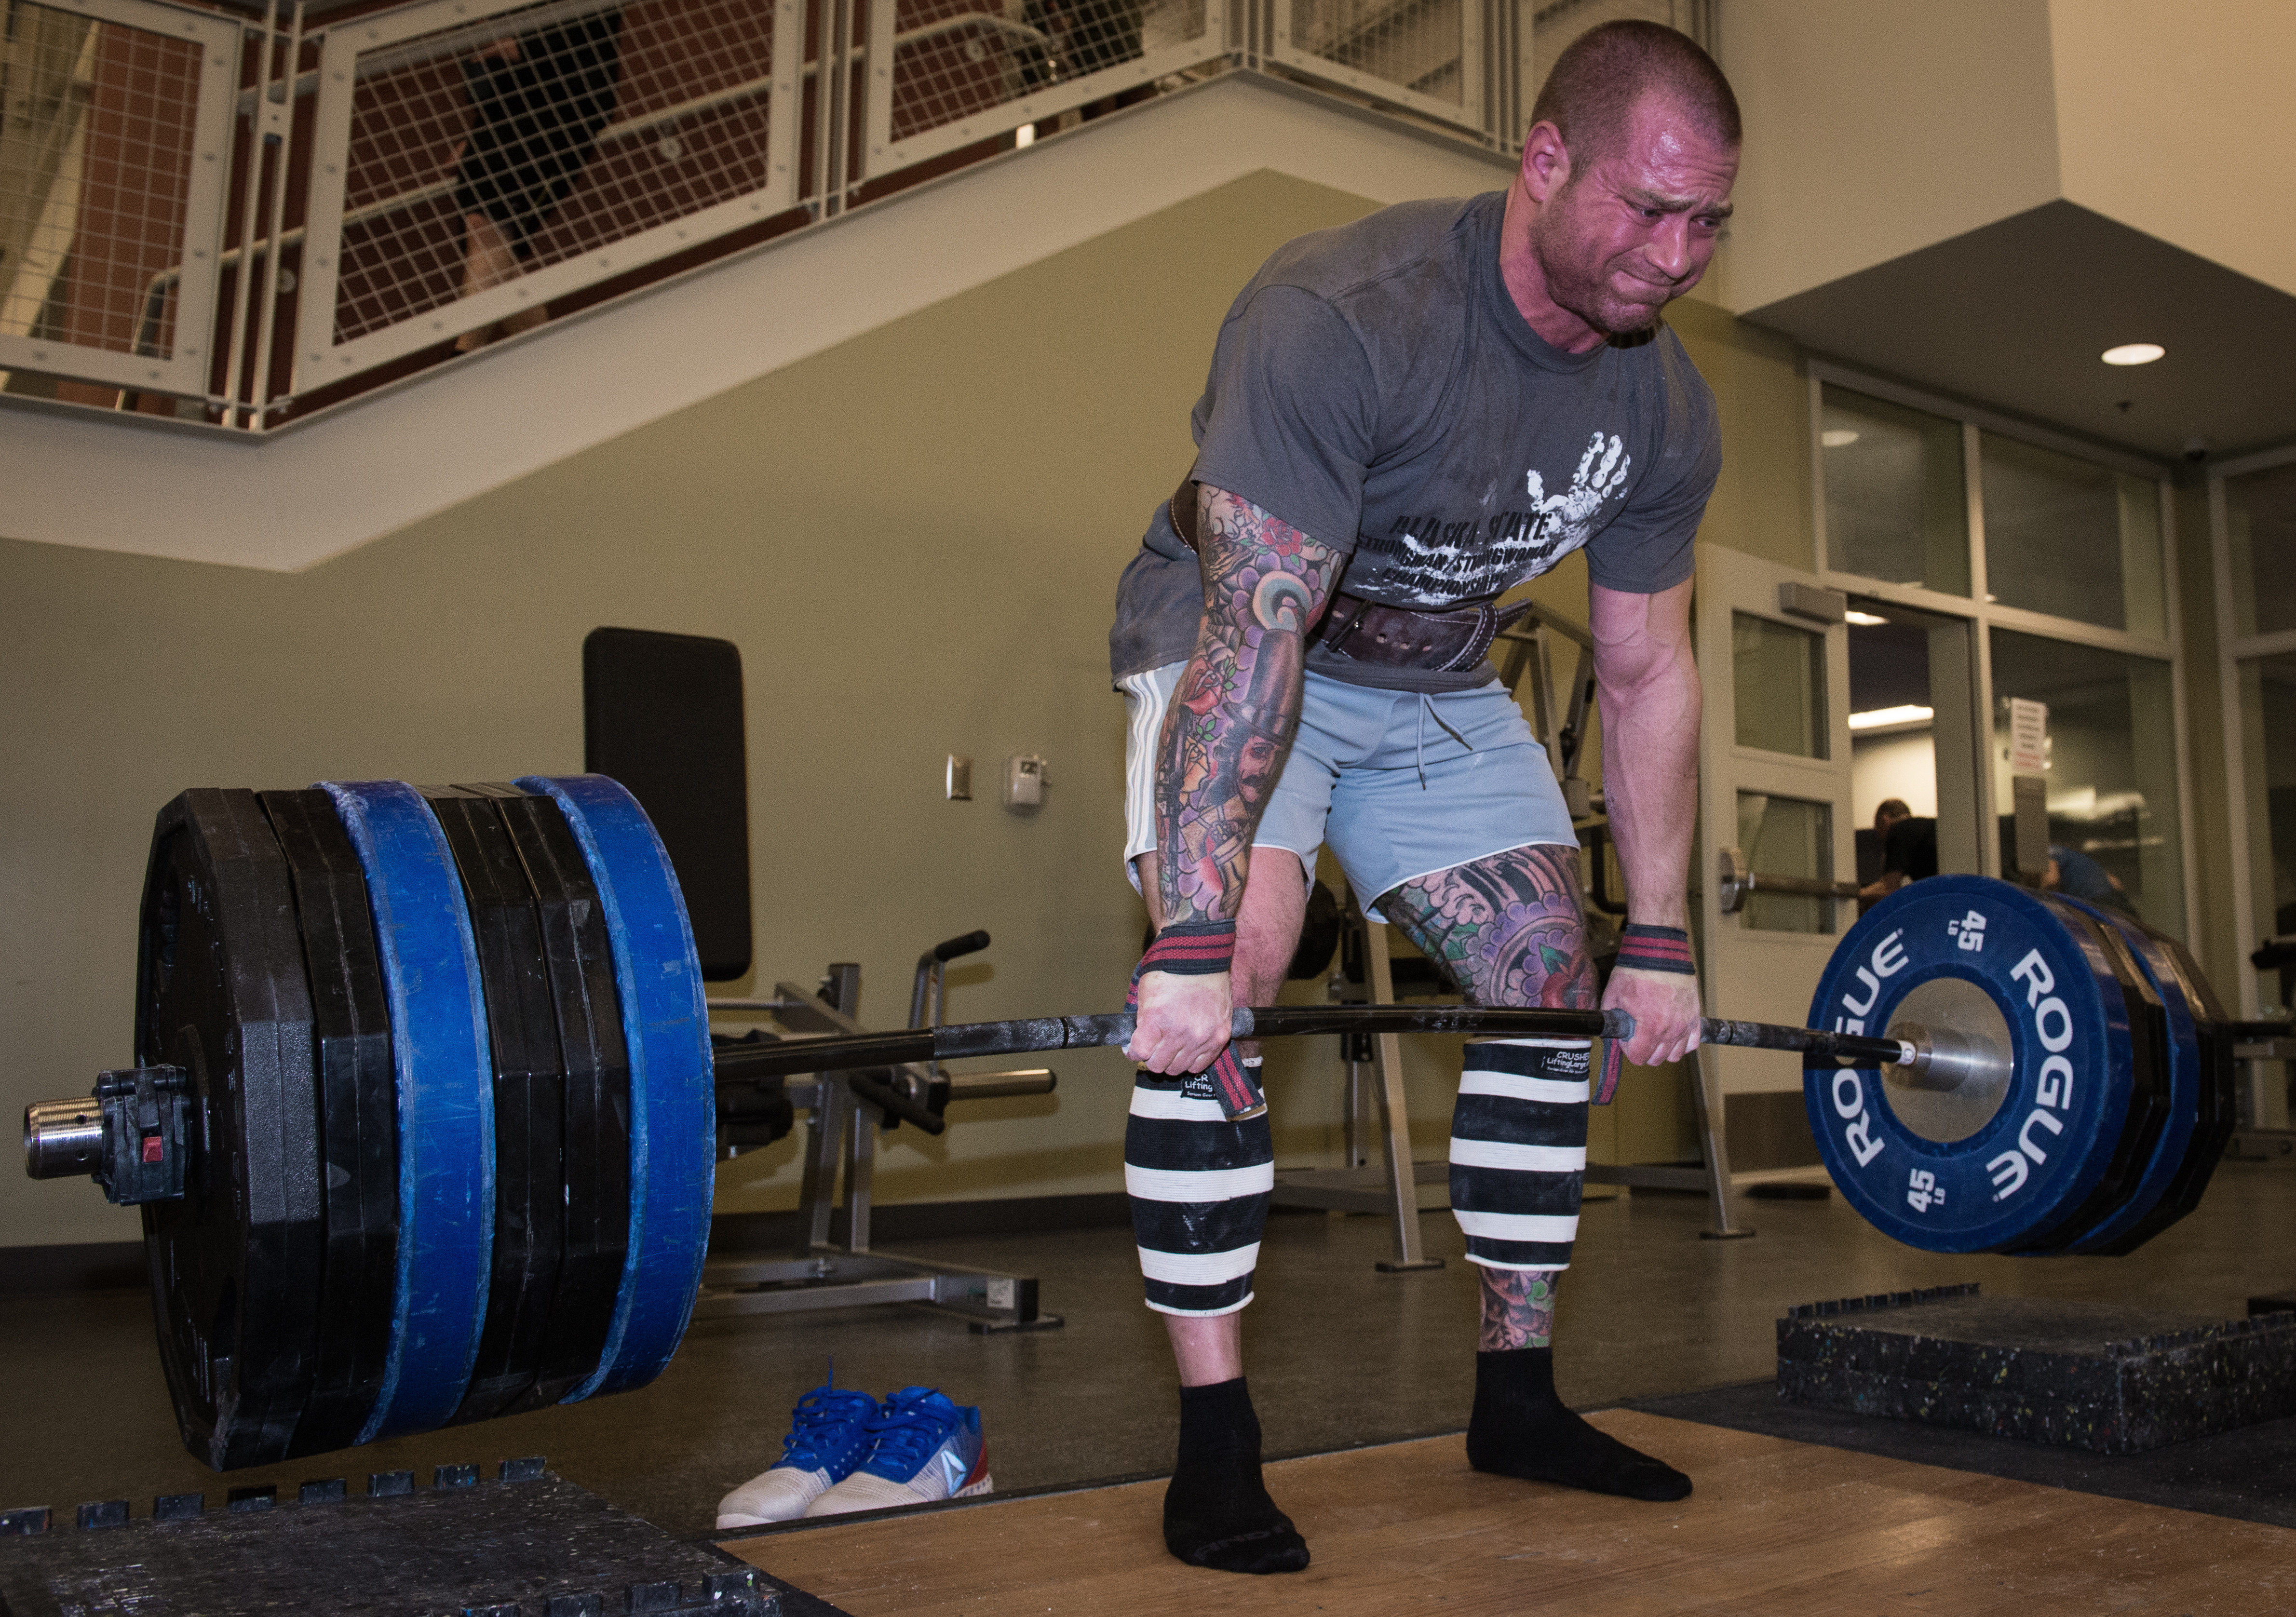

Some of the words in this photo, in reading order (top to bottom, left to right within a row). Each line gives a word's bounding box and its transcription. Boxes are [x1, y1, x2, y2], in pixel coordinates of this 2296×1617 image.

[1388, 514, 1480, 549] ALASKA
[1485, 511, 1552, 545] STATE
[1958, 910, 1987, 952] 45
[1985, 948, 2073, 1200] ROGUE
[1907, 1168, 1935, 1213] 45
